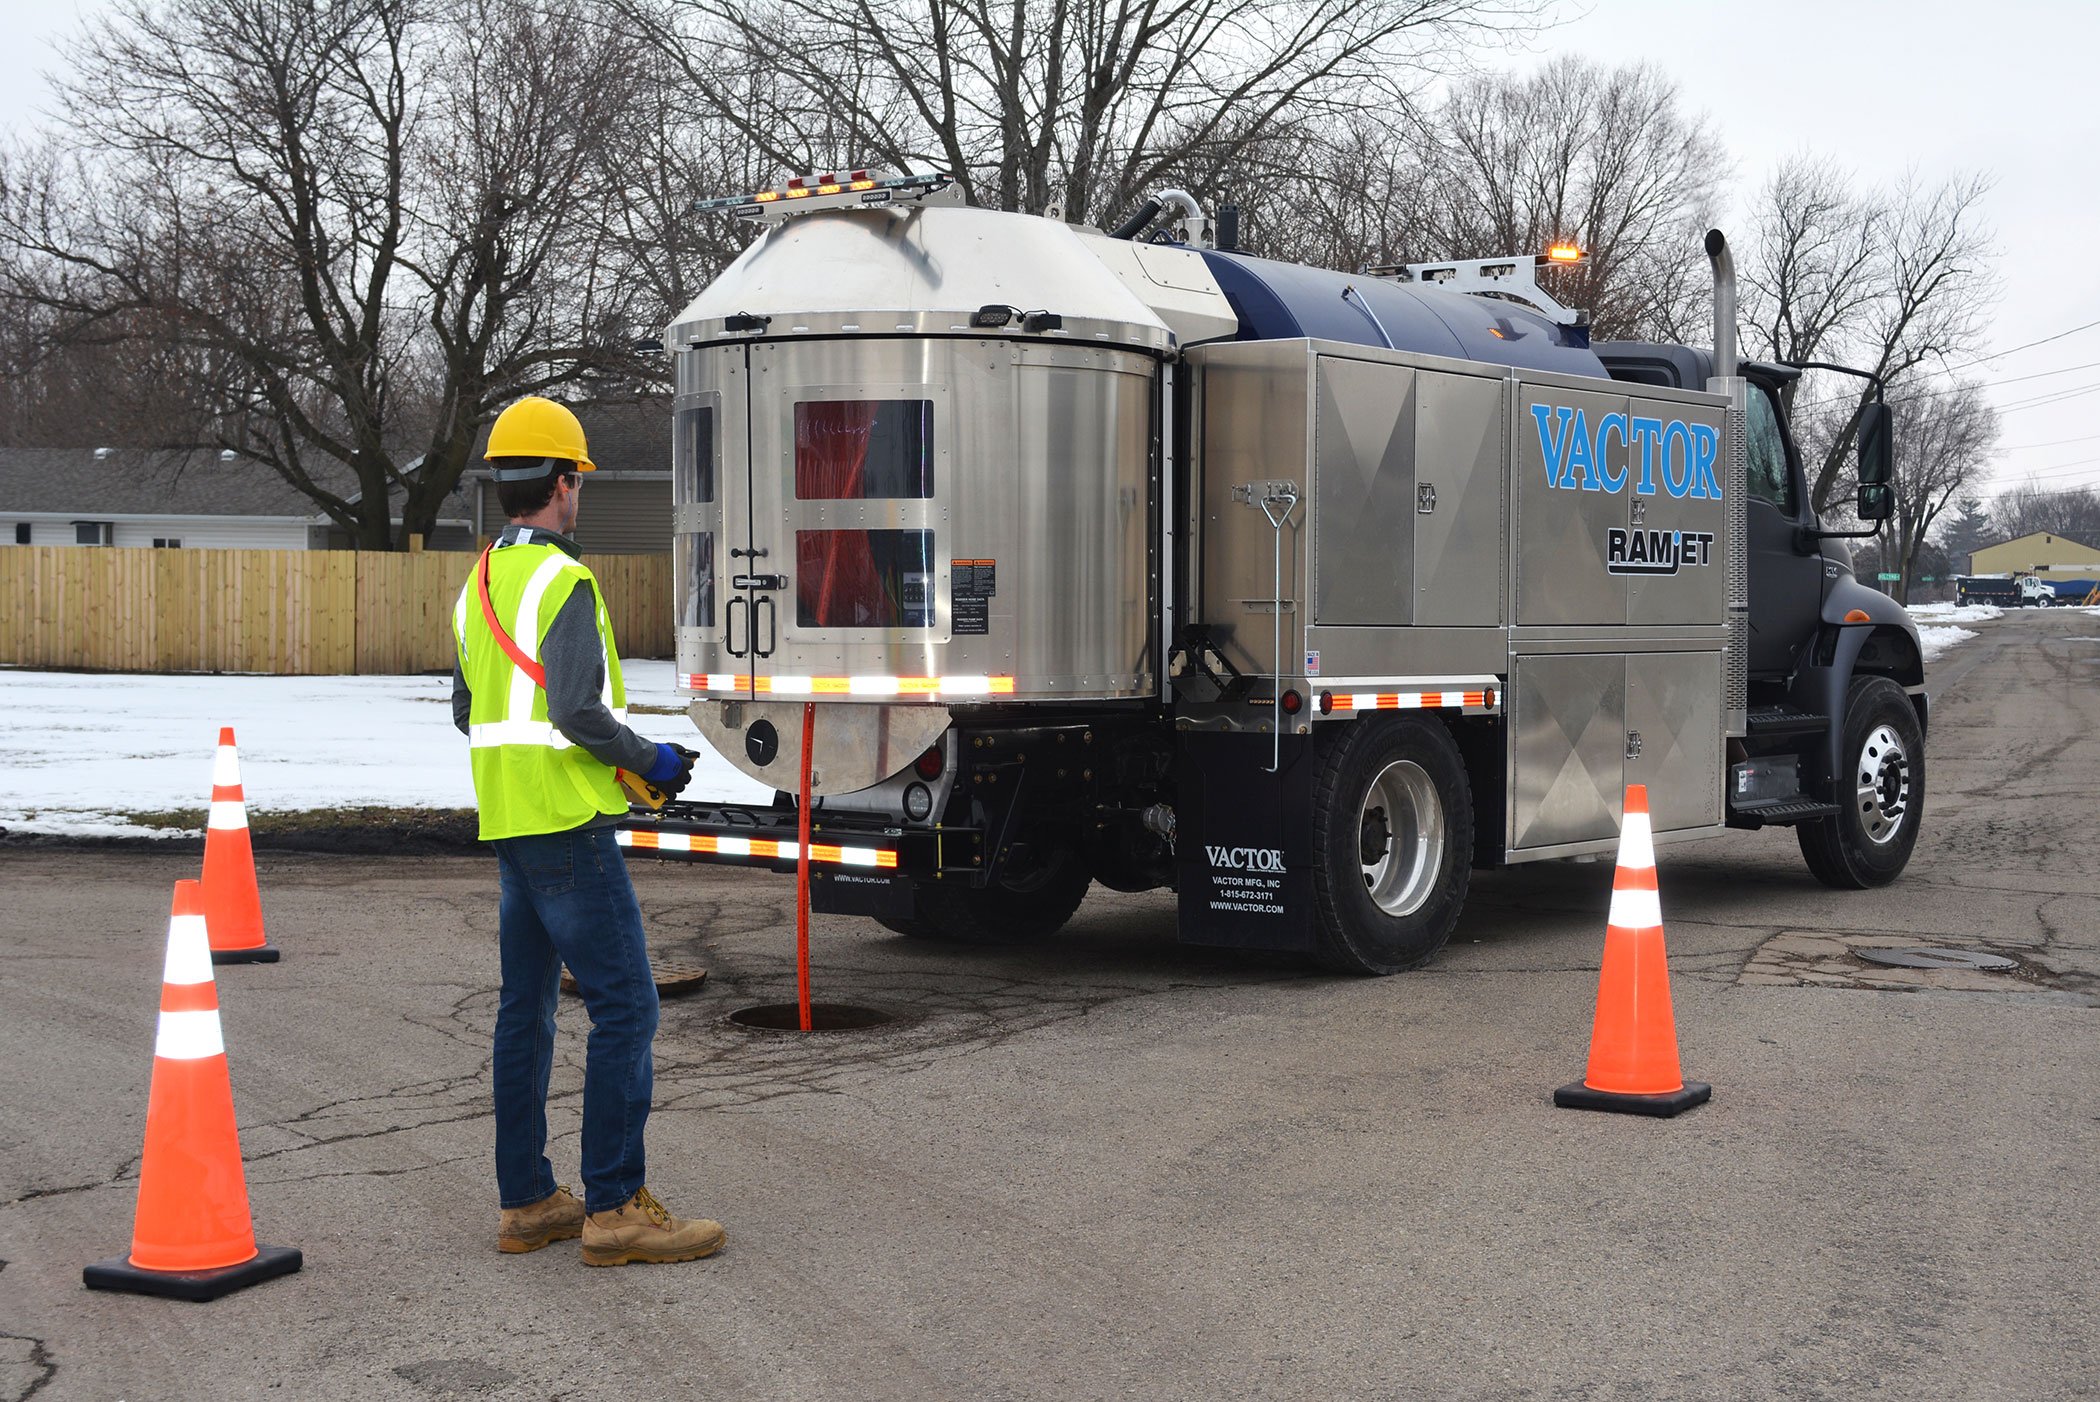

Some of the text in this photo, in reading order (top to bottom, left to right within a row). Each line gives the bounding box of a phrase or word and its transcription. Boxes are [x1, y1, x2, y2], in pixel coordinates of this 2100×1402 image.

[1205, 846, 1287, 871] VACTOR
[1212, 876, 1244, 886] VACTOR
[1267, 880, 1281, 888] INC
[1219, 890, 1274, 900] 1-815-672-3171
[1209, 901, 1285, 914] WWW.VACTOR.COM
